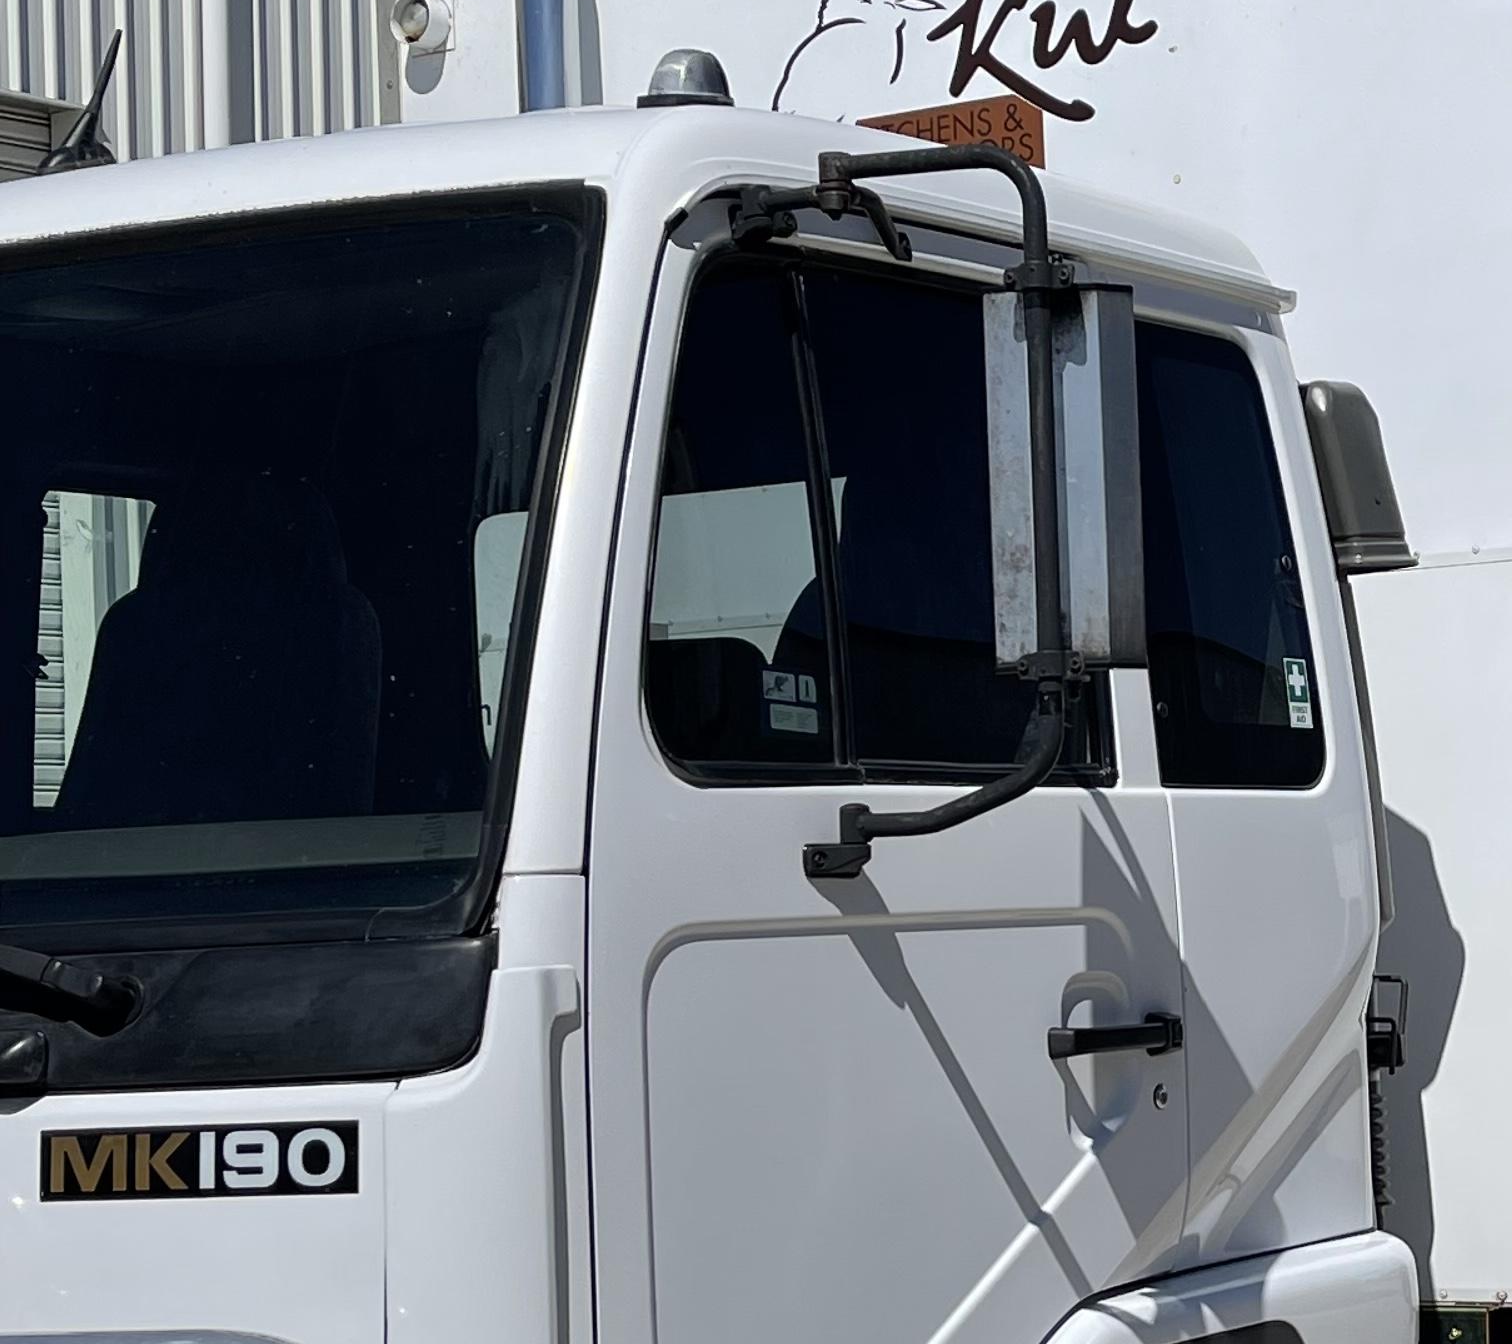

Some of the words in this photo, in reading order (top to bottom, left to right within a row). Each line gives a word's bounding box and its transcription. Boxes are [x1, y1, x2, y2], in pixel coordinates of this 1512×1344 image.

[876, 108, 993, 144] CHENS
[1003, 103, 1025, 133] &
[50, 1127, 346, 1193] MK190
